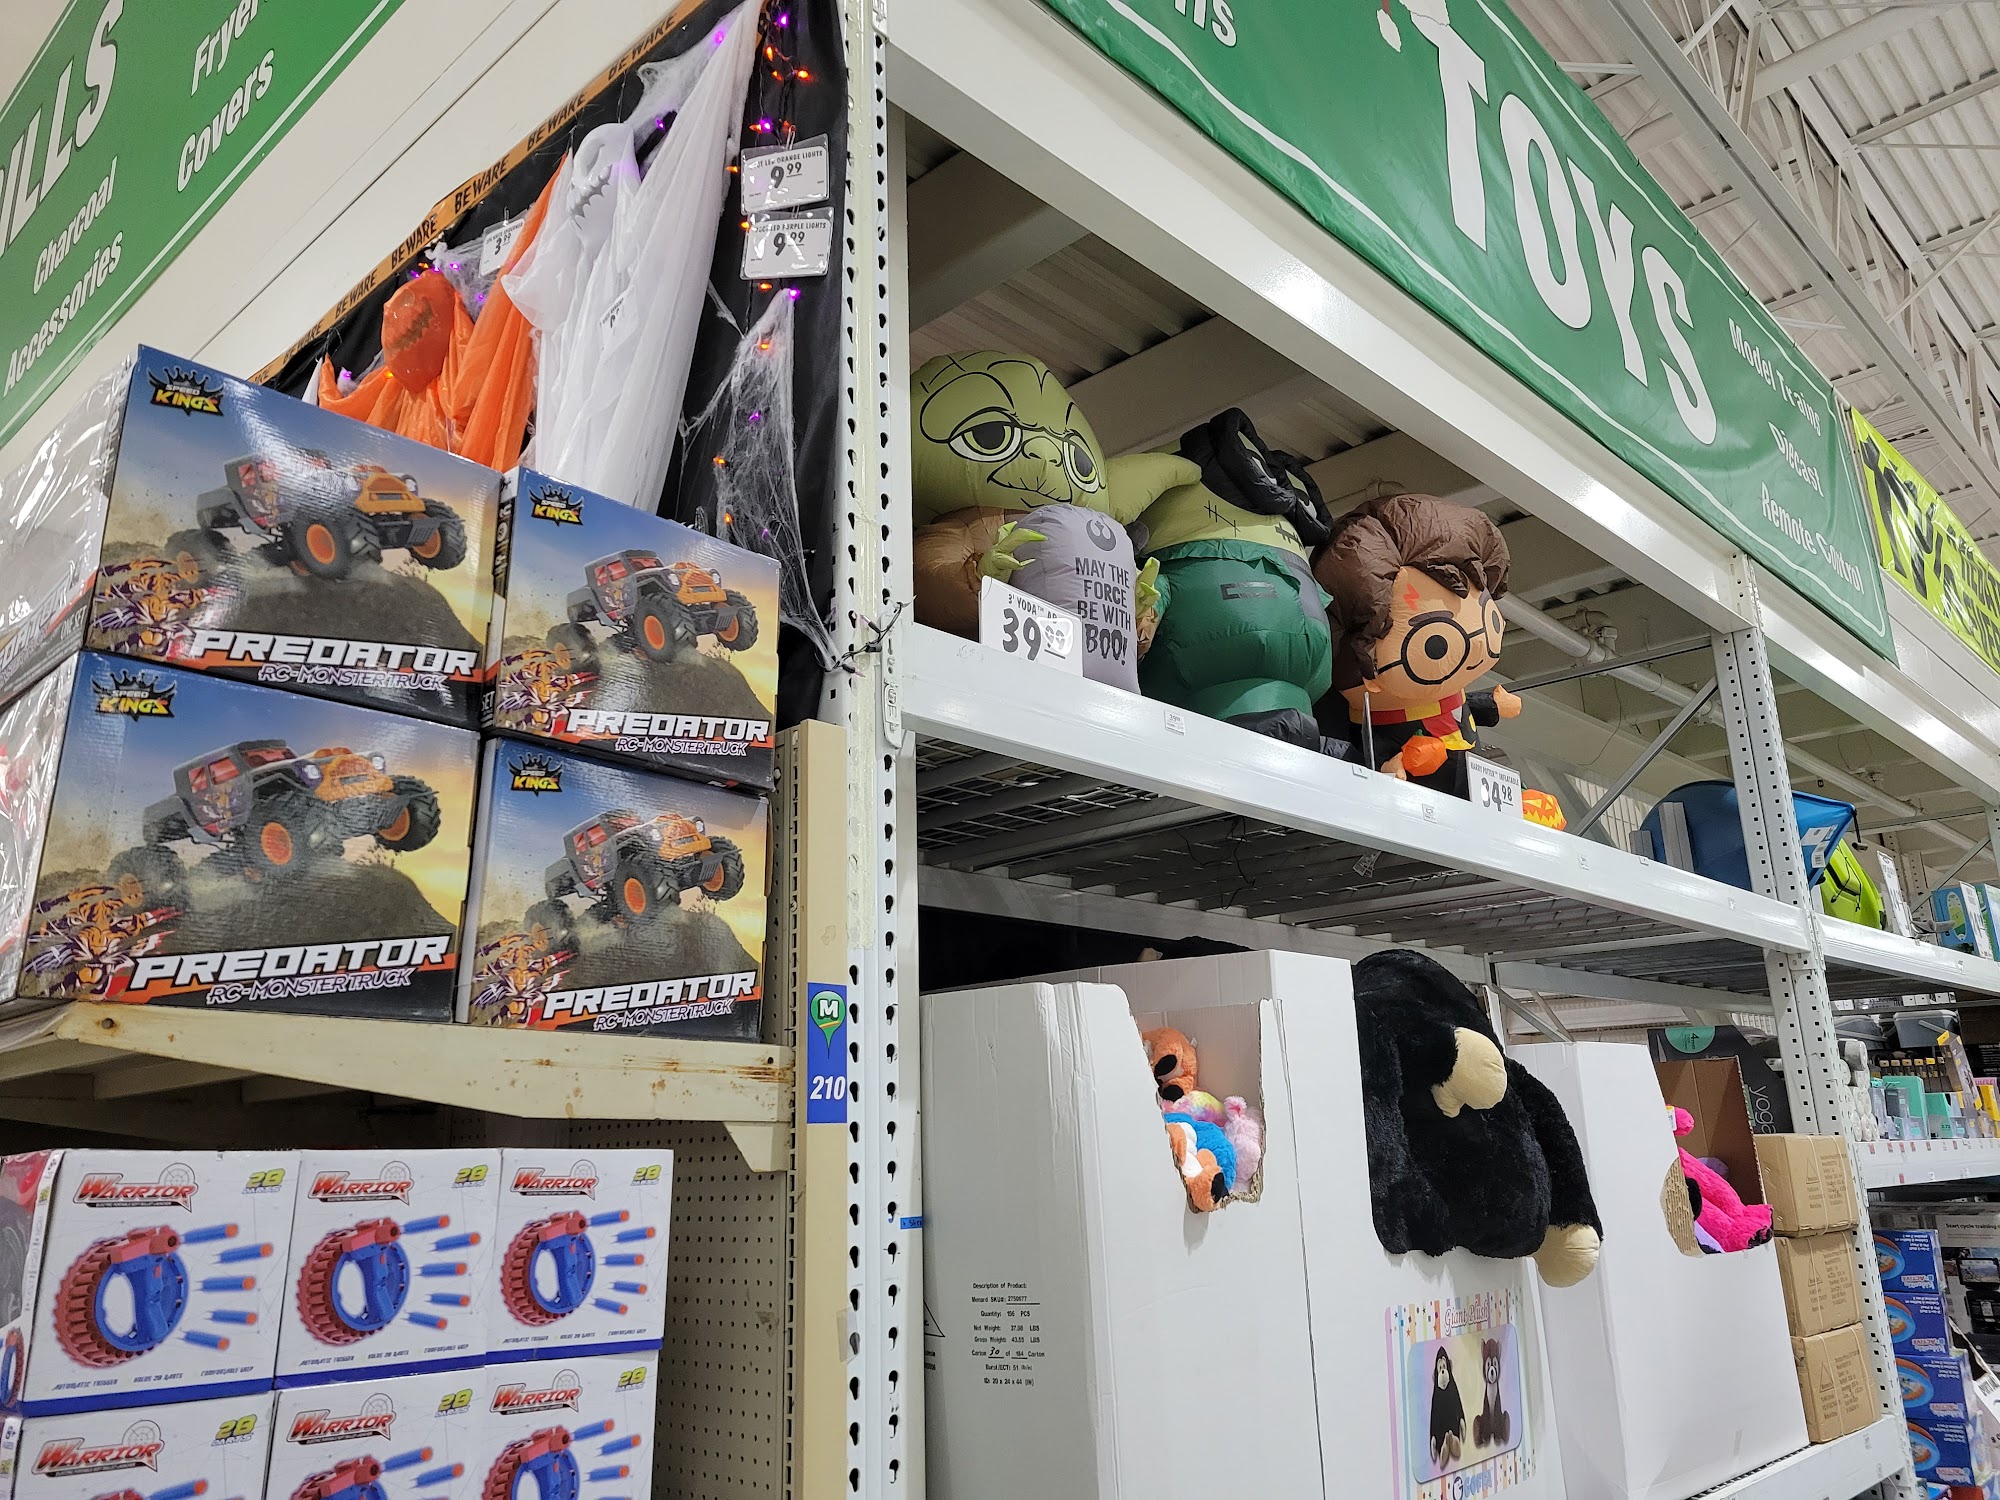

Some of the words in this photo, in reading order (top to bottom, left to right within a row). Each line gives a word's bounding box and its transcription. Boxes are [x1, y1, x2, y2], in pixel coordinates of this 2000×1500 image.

[0, 0, 123, 258] ILLS
[177, 48, 275, 193] Covers
[777, 153, 801, 164] ORANGE
[802, 150, 823, 159] LIGHTS
[33, 154, 118, 295] Charcoal
[334, 268, 379, 319] BEWARE
[390, 213, 438, 271] BEWARE
[453, 153, 510, 215] BEWARE
[806, 222, 827, 230] LIGHTS
[1411, 14, 1718, 447] TOYS
[3, 231, 124, 399] Accessories
[166, 384, 200, 396] SPEED
[1728, 316, 1777, 392] Model
[1775, 369, 1822, 437] Trains
[154, 389, 219, 414] KINGS
[1767, 421, 1825, 498] Diecast
[532, 505, 581, 523] KINGS
[541, 499, 567, 509] SPEED
[1761, 480, 1818, 556] Remote
[1815, 531, 1865, 595] Control
[1075, 557, 1108, 579] MAY
[1108, 563, 1130, 589] THE
[1083, 579, 1127, 609] FORCE
[1077, 600, 1099, 621] BE
[1102, 603, 1132, 632] WITH
[196, 629, 479, 676] PREDATOR
[1085, 623, 1129, 666] BOO!
[98, 696, 171, 717] KINGS
[112, 688, 150, 700] SPEED
[567, 707, 770, 743] PREDATOR
[511, 776, 560, 791] KINGS
[129, 935, 451, 990] PREDATOR
[542, 970, 757, 1019] PREDATOR
[817, 998, 840, 1019] M
[810, 1074, 847, 1102] 210
[246, 1168, 286, 1188] 28
[454, 1164, 488, 1183] 28
[633, 1164, 662, 1181] 28
[972, 1282, 999, 1290] Description
[1445, 1307, 1467, 1336] Giant
[989, 1346, 1000, 1356] 30
[618, 1366, 648, 1386] 28
[437, 1388, 474, 1412] 28
[215, 1413, 258, 1440] 28
